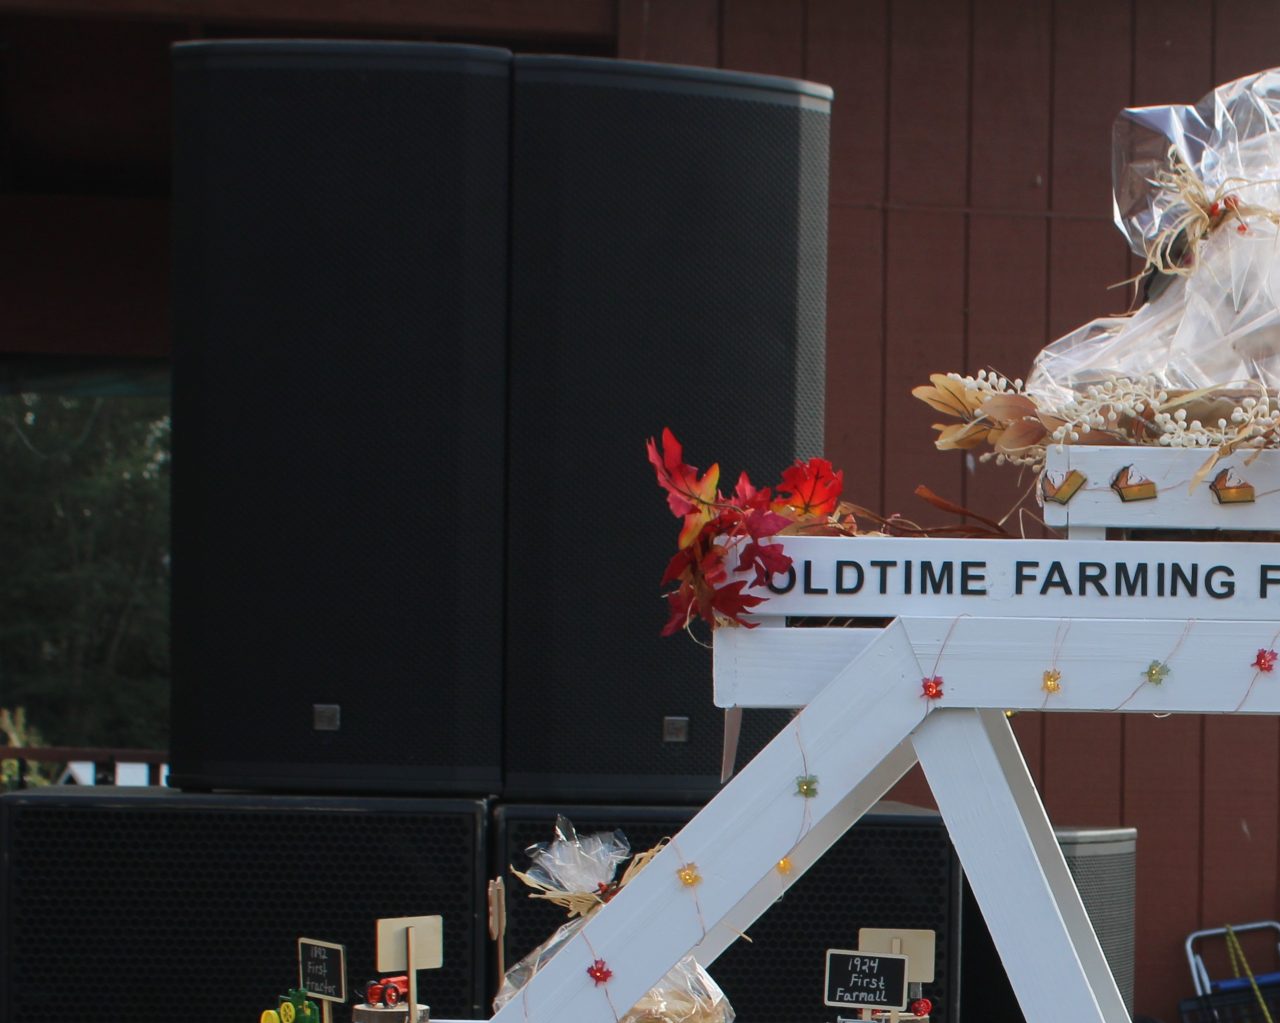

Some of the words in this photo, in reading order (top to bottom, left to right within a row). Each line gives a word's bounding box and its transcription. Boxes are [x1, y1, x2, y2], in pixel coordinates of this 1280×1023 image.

[765, 560, 987, 596] OLDTIME
[1015, 561, 1236, 599] FARMING
[307, 961, 328, 976] First
[848, 957, 879, 974] 1924
[849, 974, 886, 988] First
[836, 988, 887, 1002] Farmall
